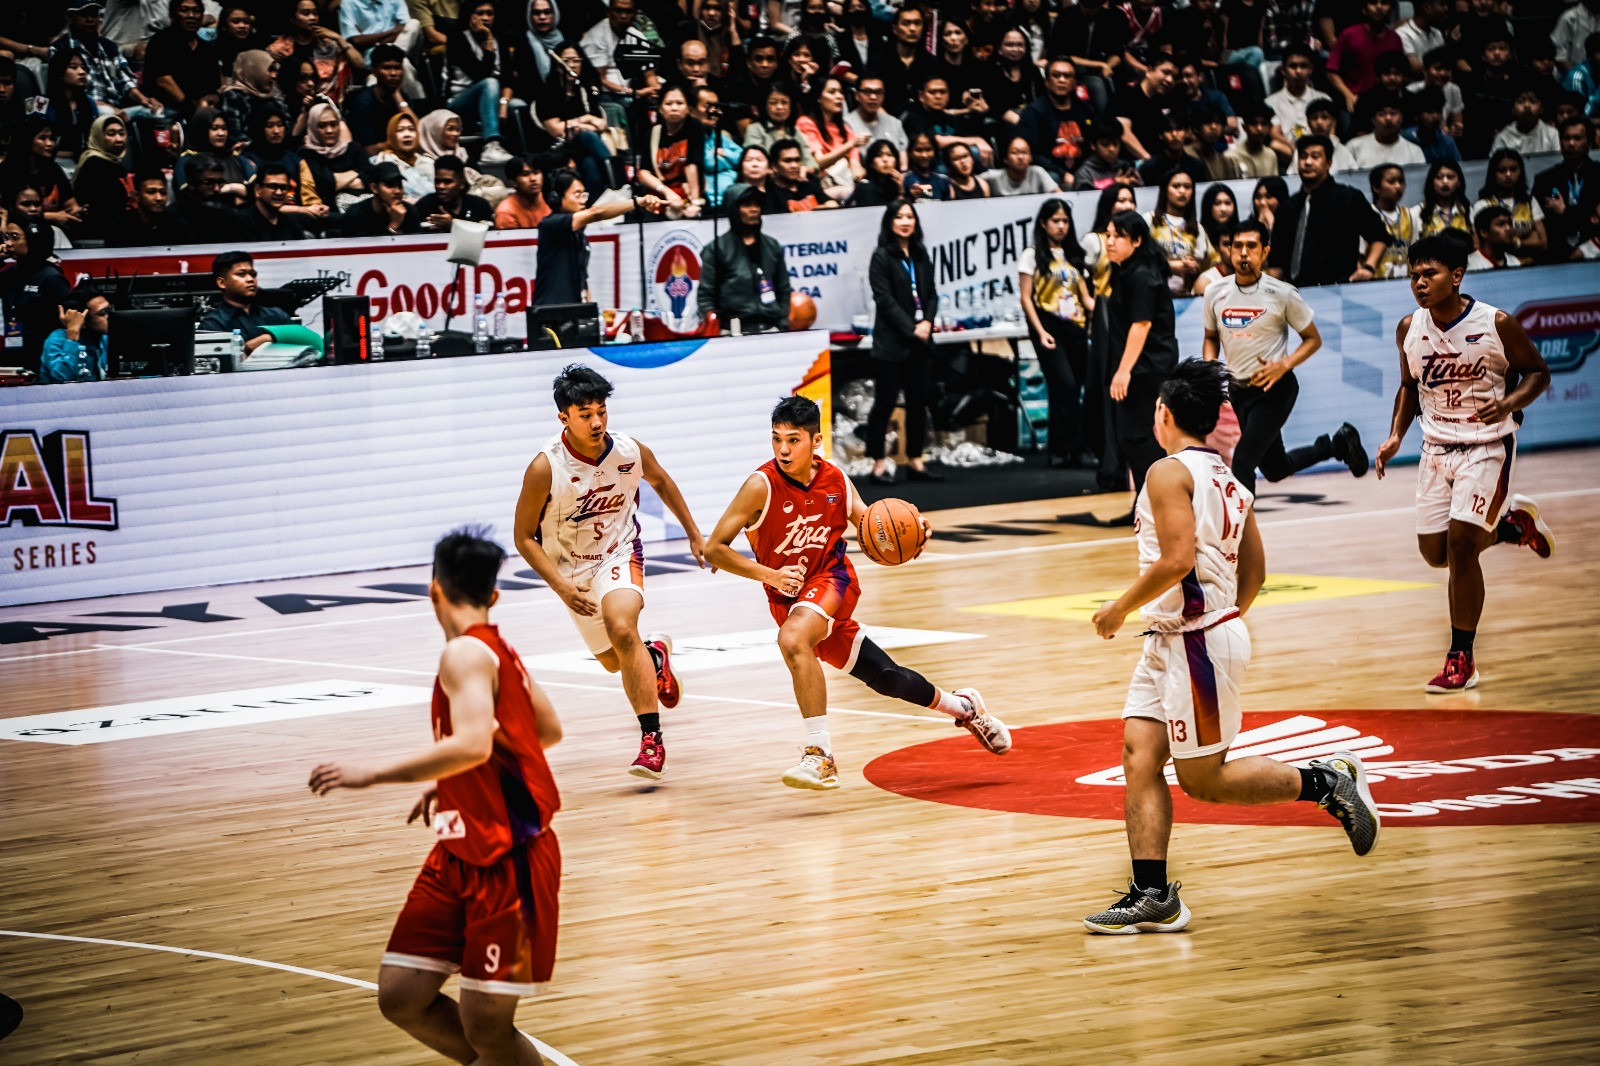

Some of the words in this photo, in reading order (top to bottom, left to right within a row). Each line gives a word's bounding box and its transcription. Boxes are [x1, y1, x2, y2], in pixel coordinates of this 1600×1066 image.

[783, 240, 848, 257] TERIAN
[803, 262, 838, 278] DAN
[474, 263, 537, 316] Da
[1540, 311, 1600, 328] HONDA
[1421, 352, 1487, 389] Final
[1443, 389, 1462, 407] 12
[565, 483, 626, 522] Fina
[1471, 493, 1486, 515] 12
[593, 522, 605, 541] 5
[774, 513, 832, 556] Fina
[13, 541, 97, 571] SERIES
[1168, 719, 1188, 743] 13
[484, 942, 501, 973] 9
